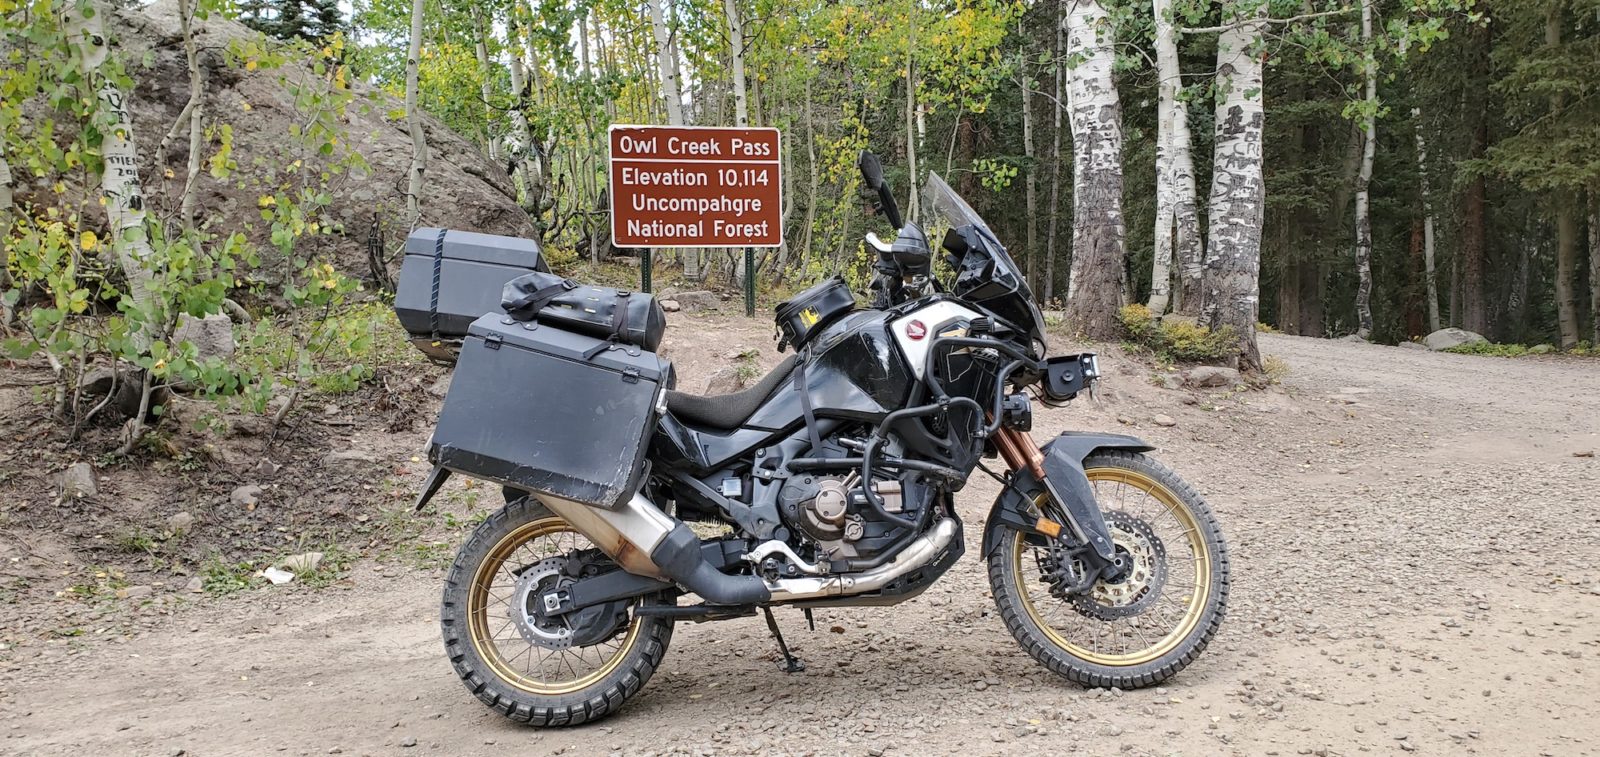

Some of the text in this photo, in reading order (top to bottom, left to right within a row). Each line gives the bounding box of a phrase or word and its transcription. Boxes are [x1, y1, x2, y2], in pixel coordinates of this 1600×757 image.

[620, 136, 770, 155] Owl Creek Pass
[622, 168, 769, 188] Elevation 10,114
[632, 194, 762, 217] Uncompahgre
[627, 220, 768, 237] National Forest
